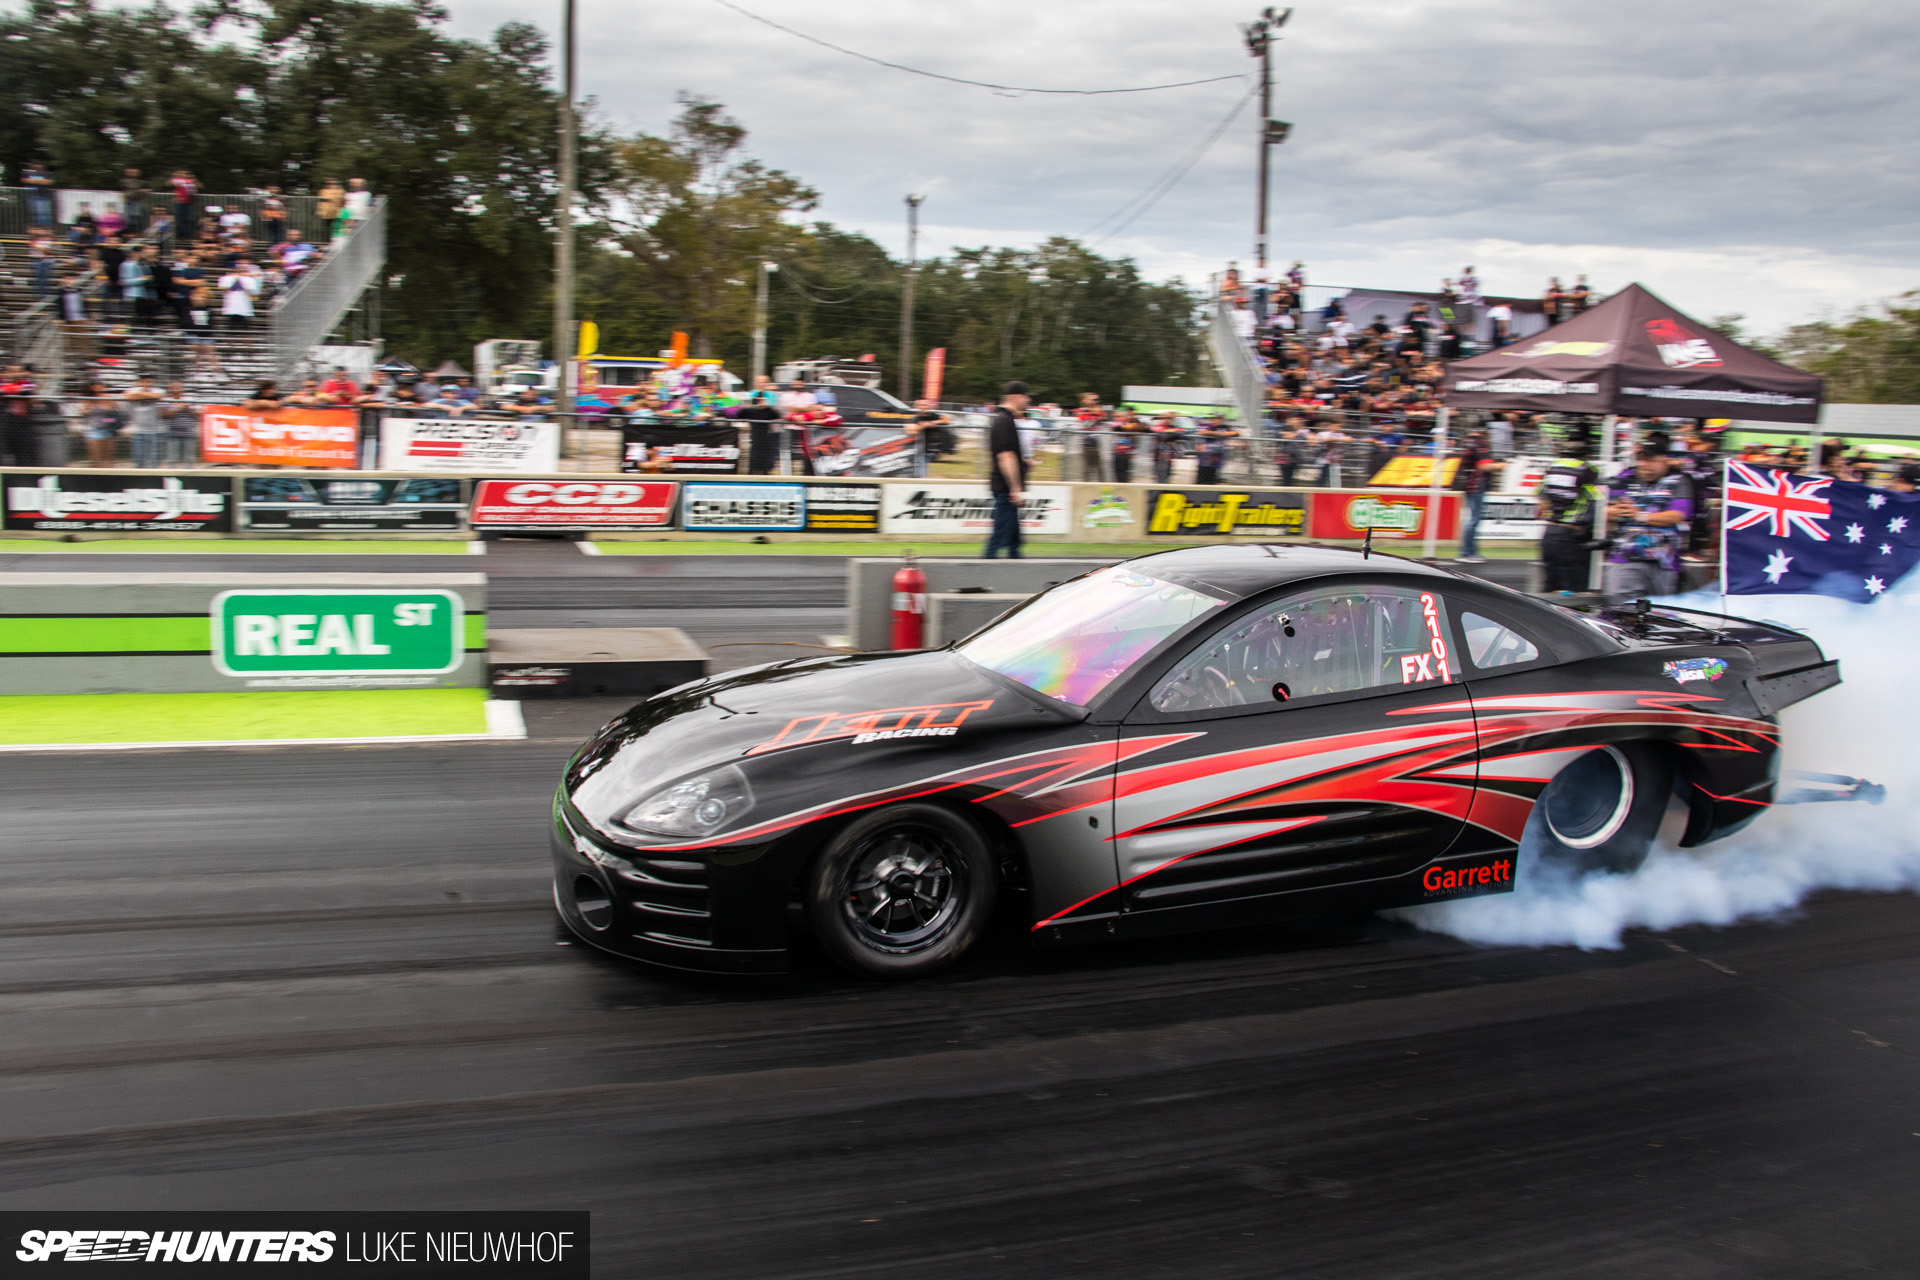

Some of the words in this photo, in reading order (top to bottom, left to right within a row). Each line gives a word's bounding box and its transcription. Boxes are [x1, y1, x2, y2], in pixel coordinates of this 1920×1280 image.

[503, 483, 647, 505] CCD
[691, 501, 801, 515] CHASSIS
[233, 614, 391, 656] REAL
[393, 603, 437, 627] ST
[1420, 592, 1452, 684] 2101
[1400, 652, 1435, 684] FX
[851, 727, 959, 745] RACING
[1423, 859, 1511, 891] Garrett
[1423, 885, 1473, 898] ADVANCING
[1476, 880, 1510, 891] MOTION
